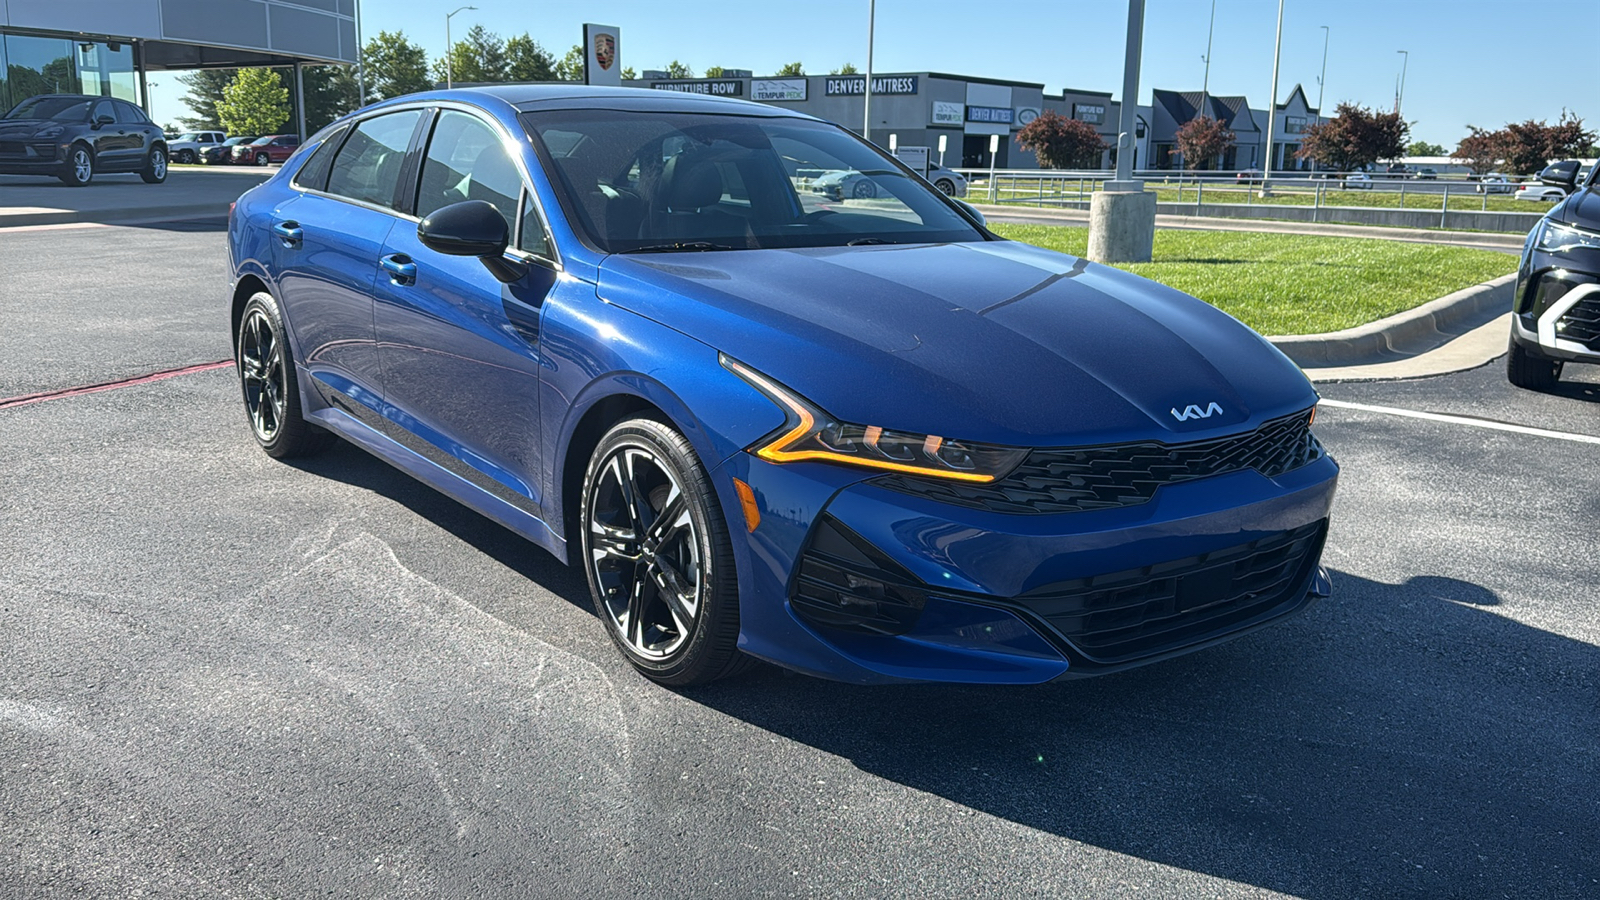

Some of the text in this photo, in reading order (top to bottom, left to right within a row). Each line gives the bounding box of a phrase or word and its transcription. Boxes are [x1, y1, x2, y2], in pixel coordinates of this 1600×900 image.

[712, 82, 735, 94] ROW
[828, 78, 913, 94] DENVER MATTRESS
[1171, 402, 1223, 421] KIA
